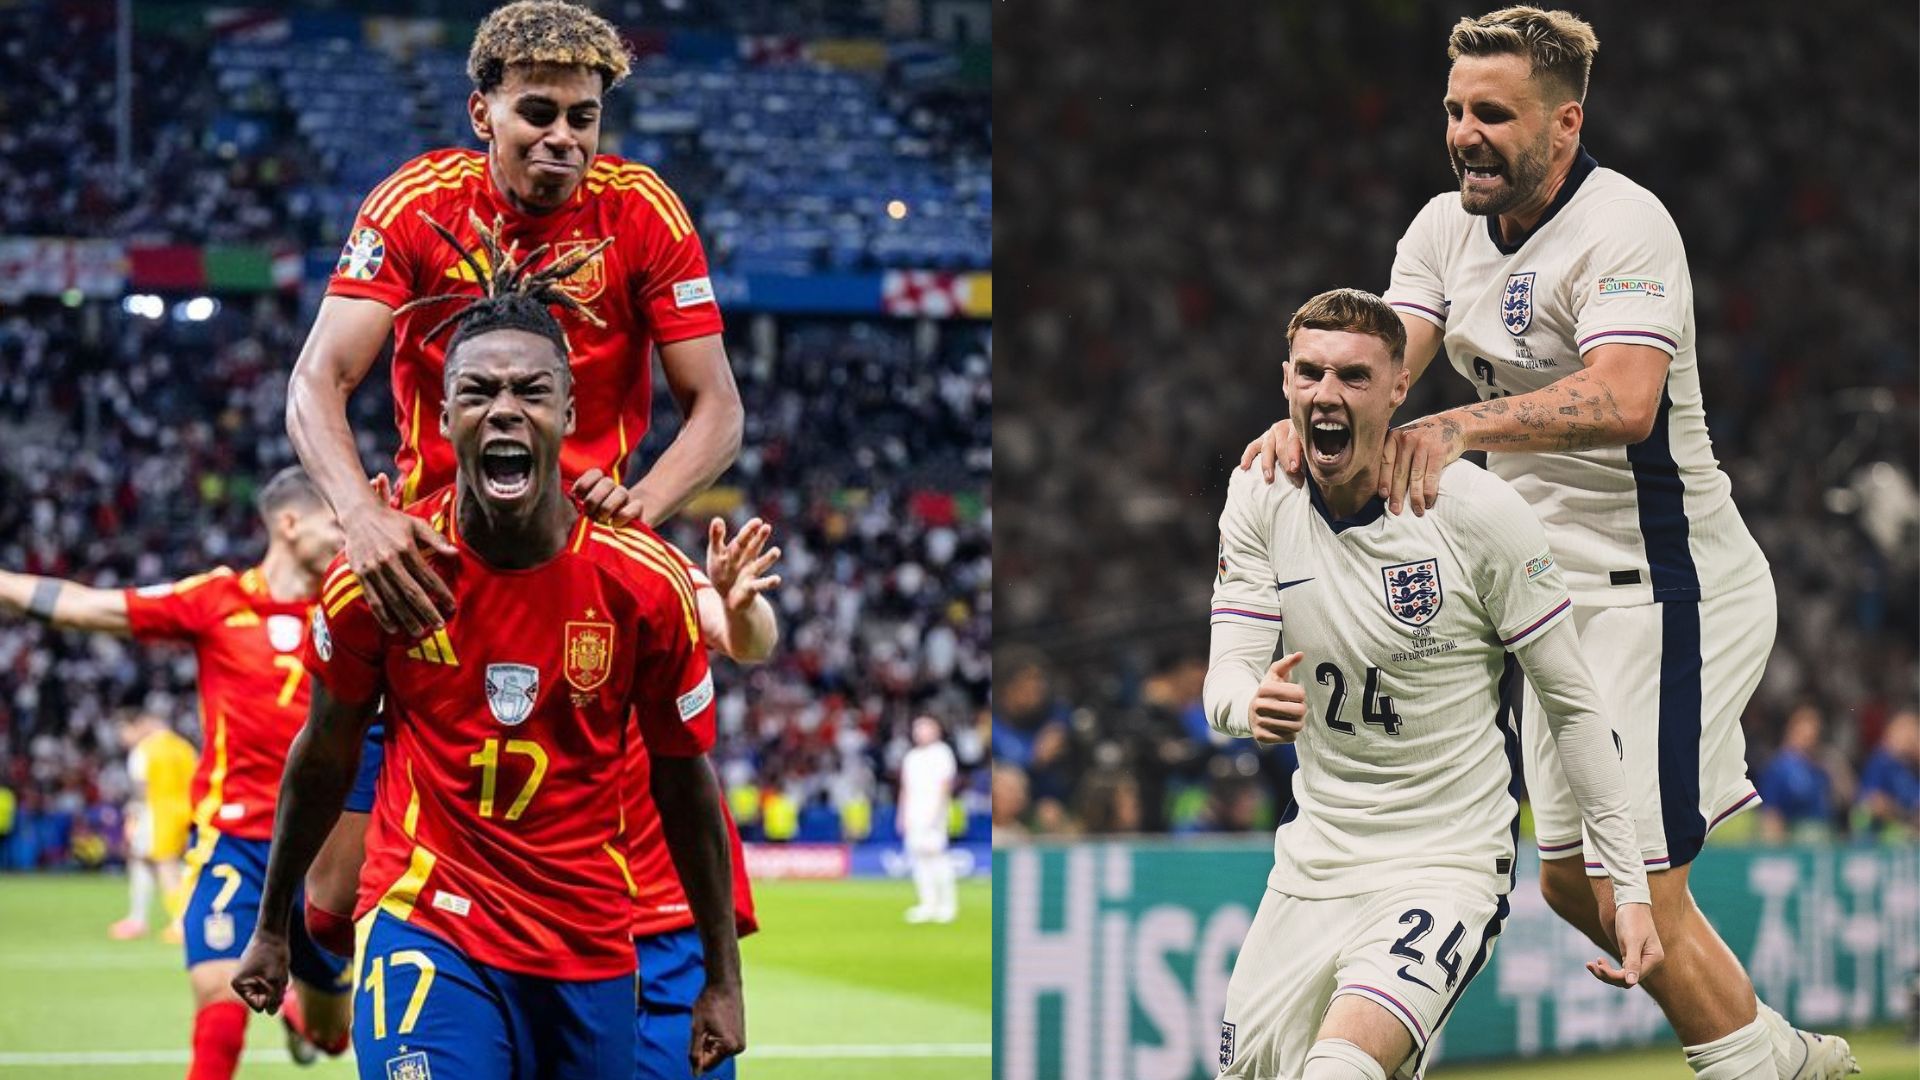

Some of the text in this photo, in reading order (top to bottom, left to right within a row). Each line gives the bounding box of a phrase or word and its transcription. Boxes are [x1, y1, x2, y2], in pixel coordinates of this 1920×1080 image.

[1599, 281, 1665, 293] FOUNDATION
[1539, 357, 1558, 369] FINAL
[1391, 639, 1458, 663] UEFA EURO 2024 FINAL
[1412, 626, 1432, 638] SPAIN
[272, 654, 304, 708] 7
[1315, 661, 1403, 736] 24
[469, 738, 549, 821] 17
[1389, 908, 1467, 993] 24
[364, 949, 437, 1041] 17
